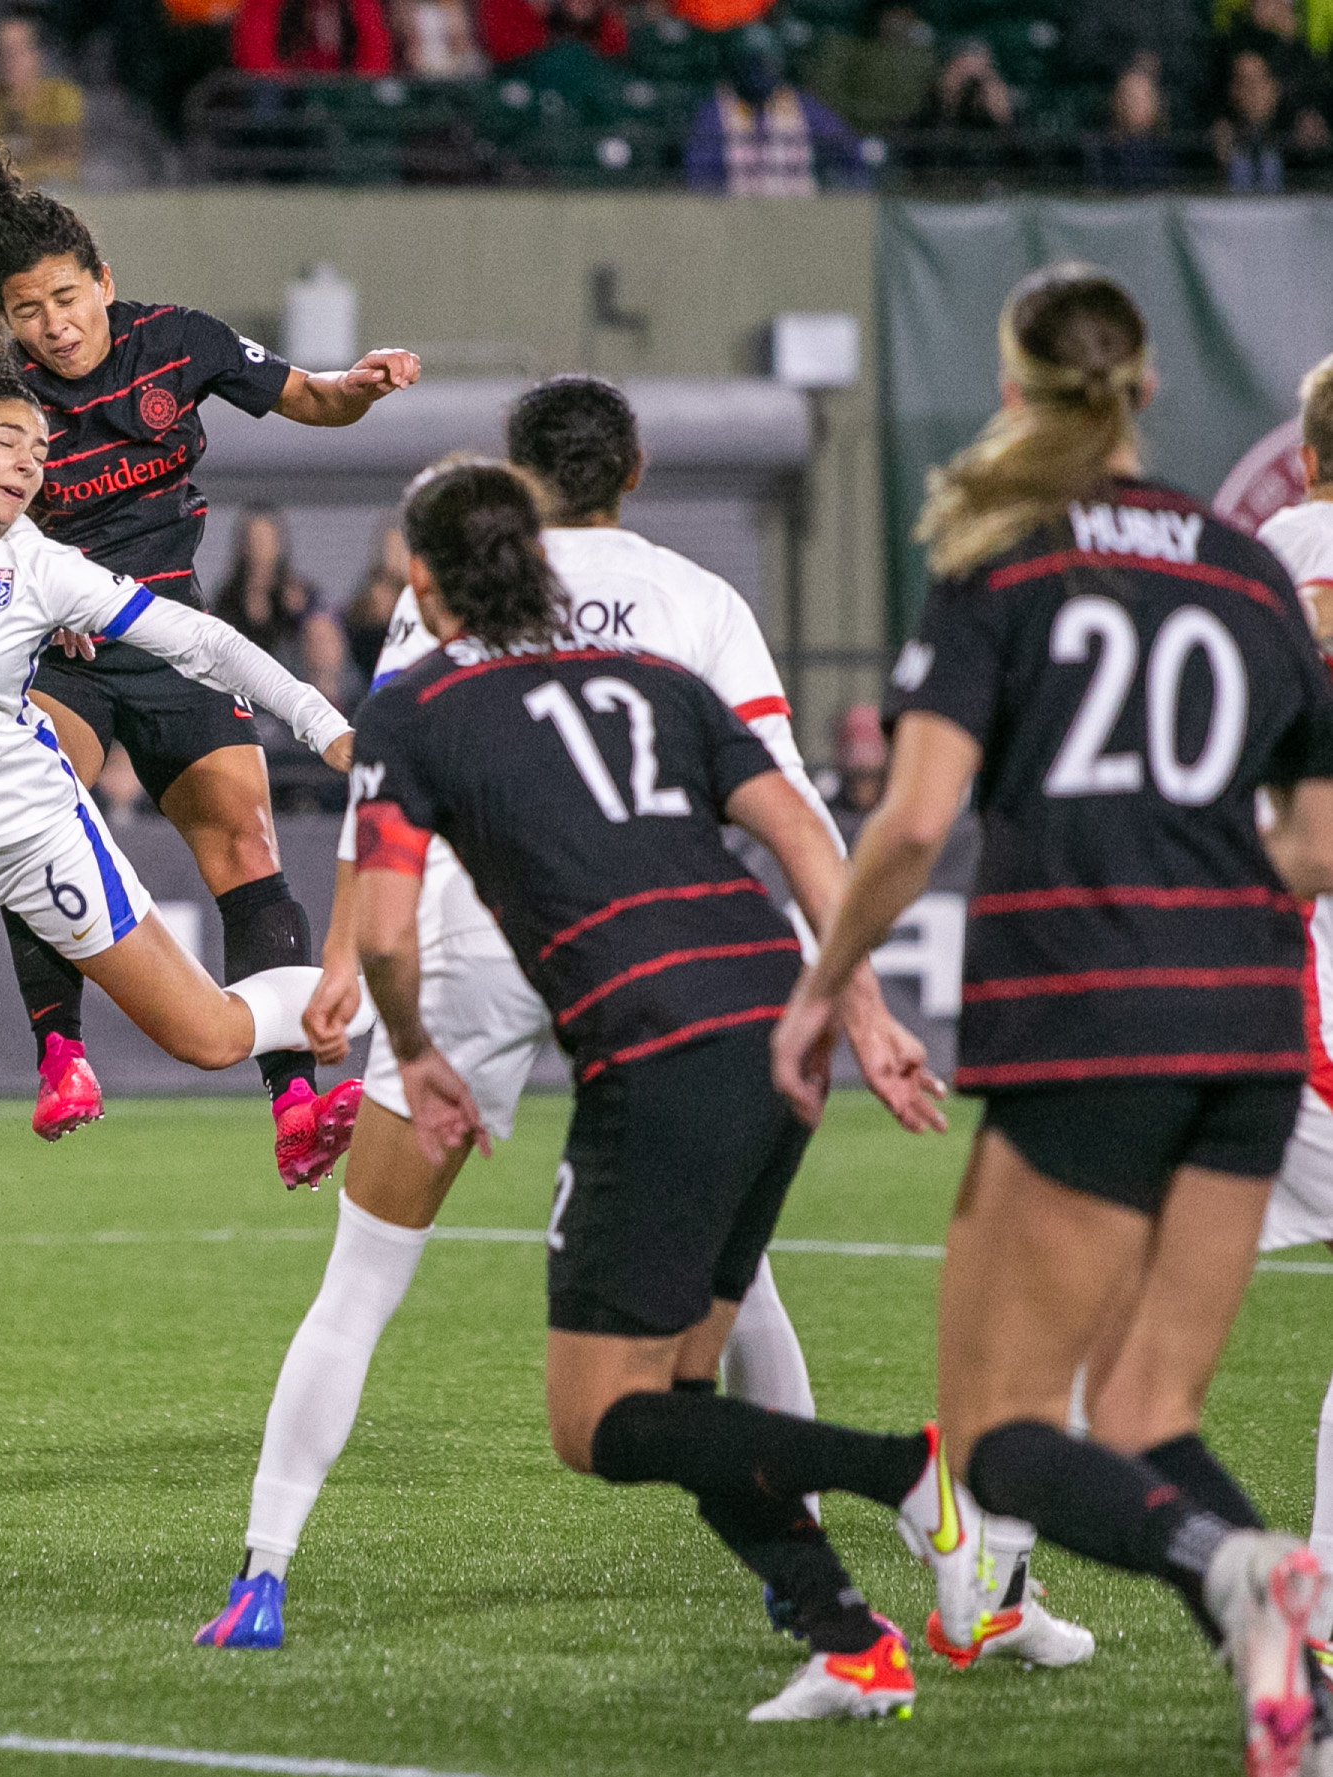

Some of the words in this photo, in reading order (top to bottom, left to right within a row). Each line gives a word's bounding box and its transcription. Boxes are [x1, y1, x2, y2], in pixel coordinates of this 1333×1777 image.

[43, 445, 186, 504] Providence
[576, 600, 637, 637] OK
[1042, 594, 1249, 807] 20
[522, 676, 692, 823] 12
[45, 861, 88, 920] 6
